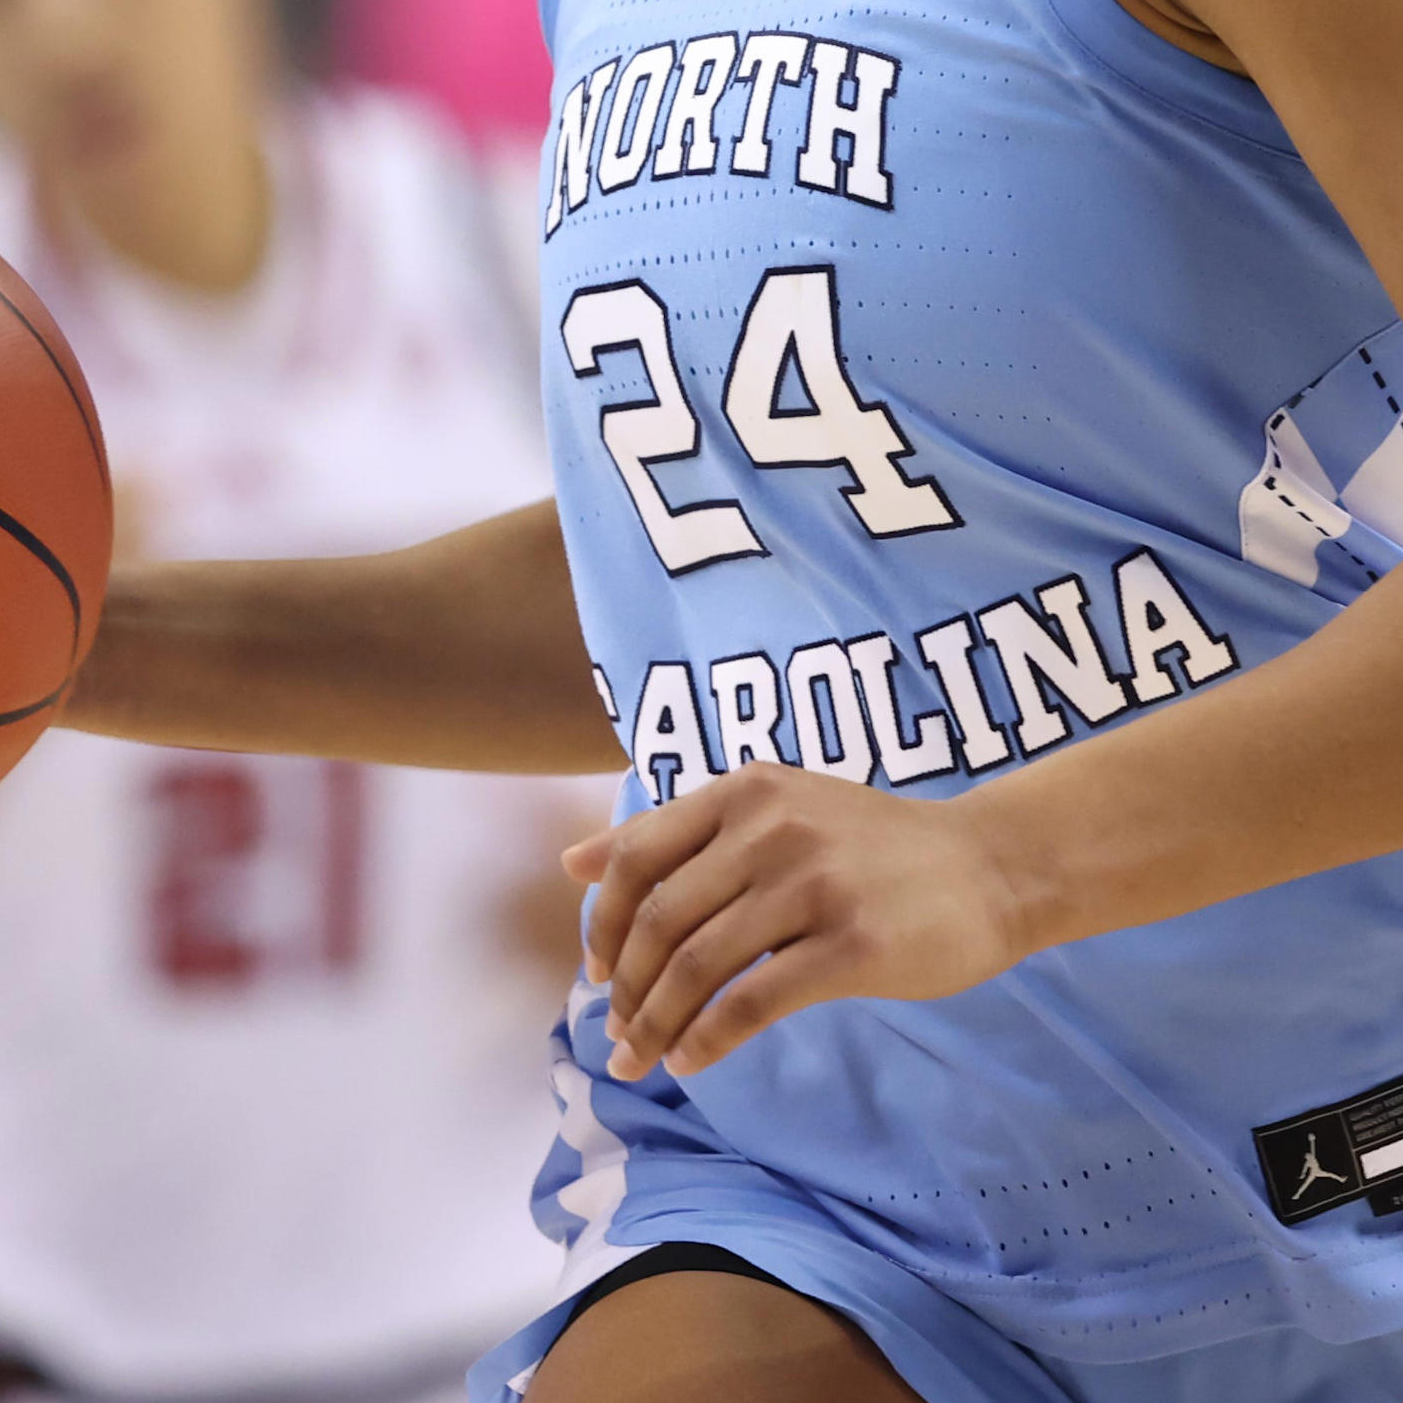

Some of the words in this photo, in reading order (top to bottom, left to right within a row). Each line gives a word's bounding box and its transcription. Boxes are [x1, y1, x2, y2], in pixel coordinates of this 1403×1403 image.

[545, 30, 902, 243] NORTH
[560, 263, 965, 578] 24
[141, 756, 370, 988] 21
